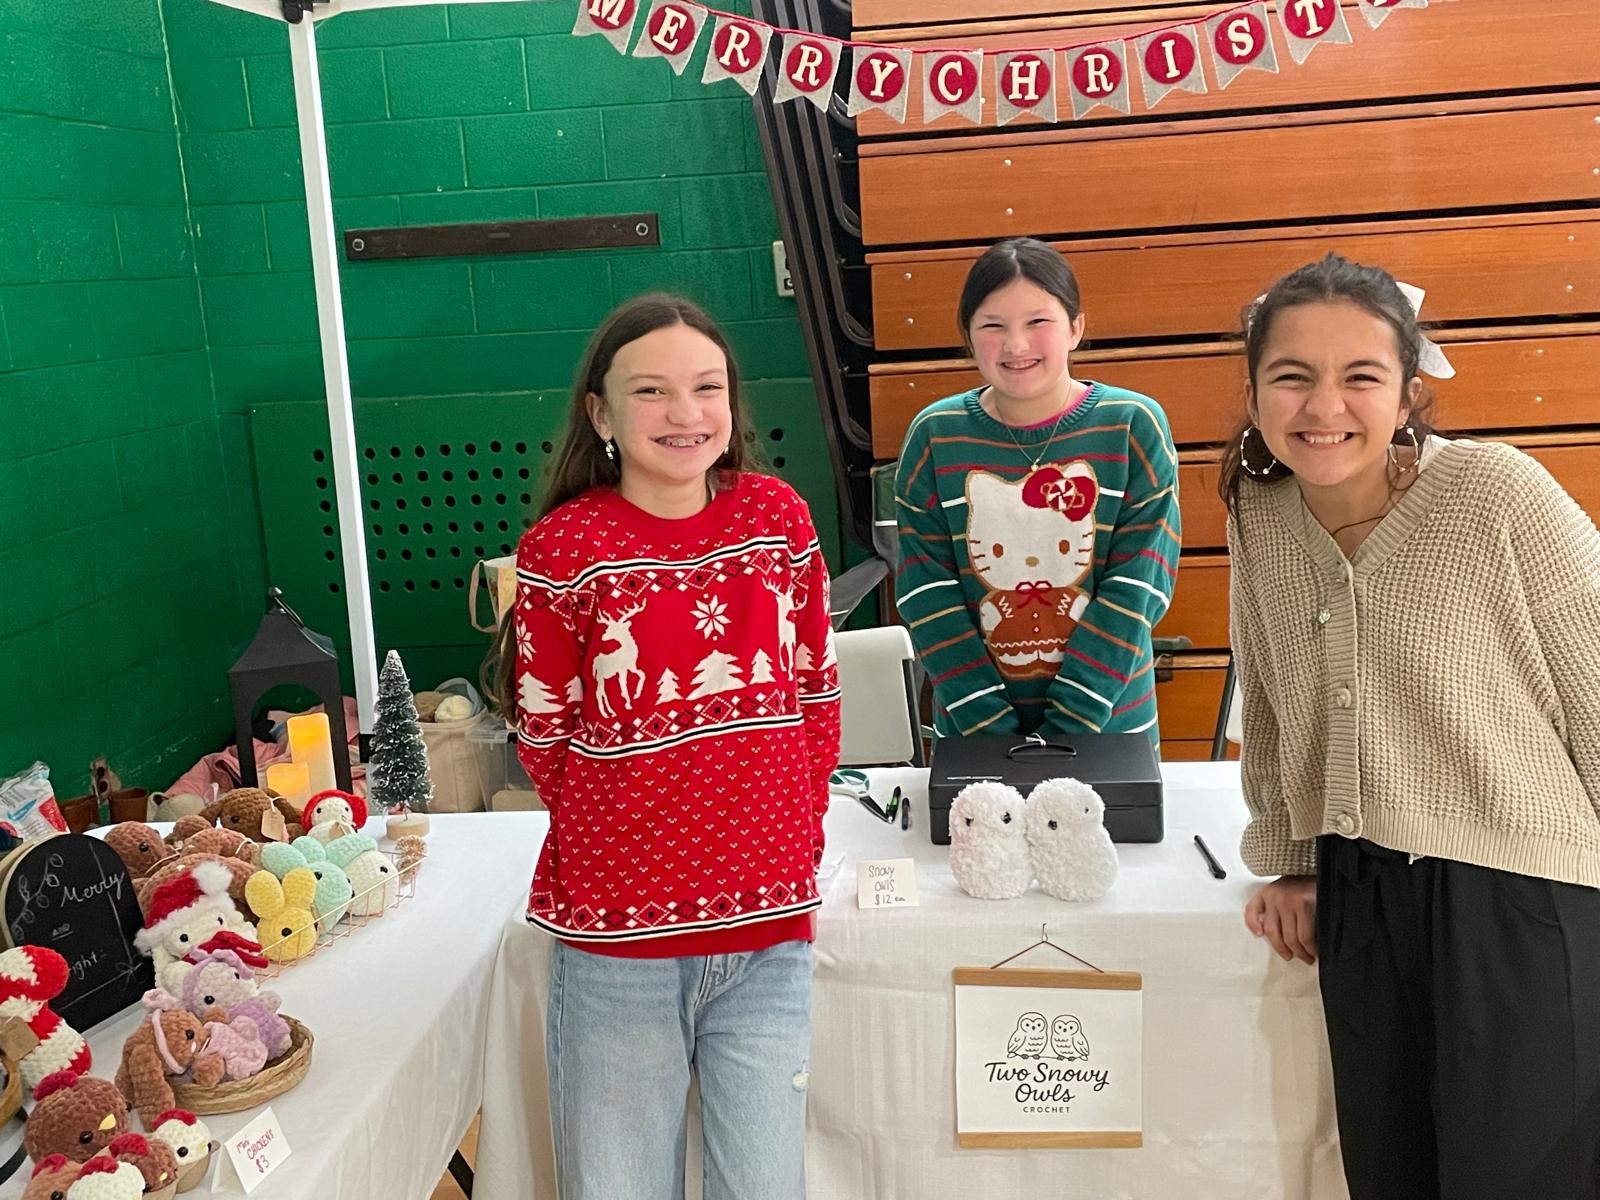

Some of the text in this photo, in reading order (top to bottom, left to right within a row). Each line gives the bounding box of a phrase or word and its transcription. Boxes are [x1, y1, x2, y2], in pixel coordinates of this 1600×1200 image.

[60, 871, 125, 908] Merry
[984, 1061, 1110, 1092] Two Snowy
[1015, 1083, 1076, 1103] Owls
[255, 1154, 270, 1173] $3
